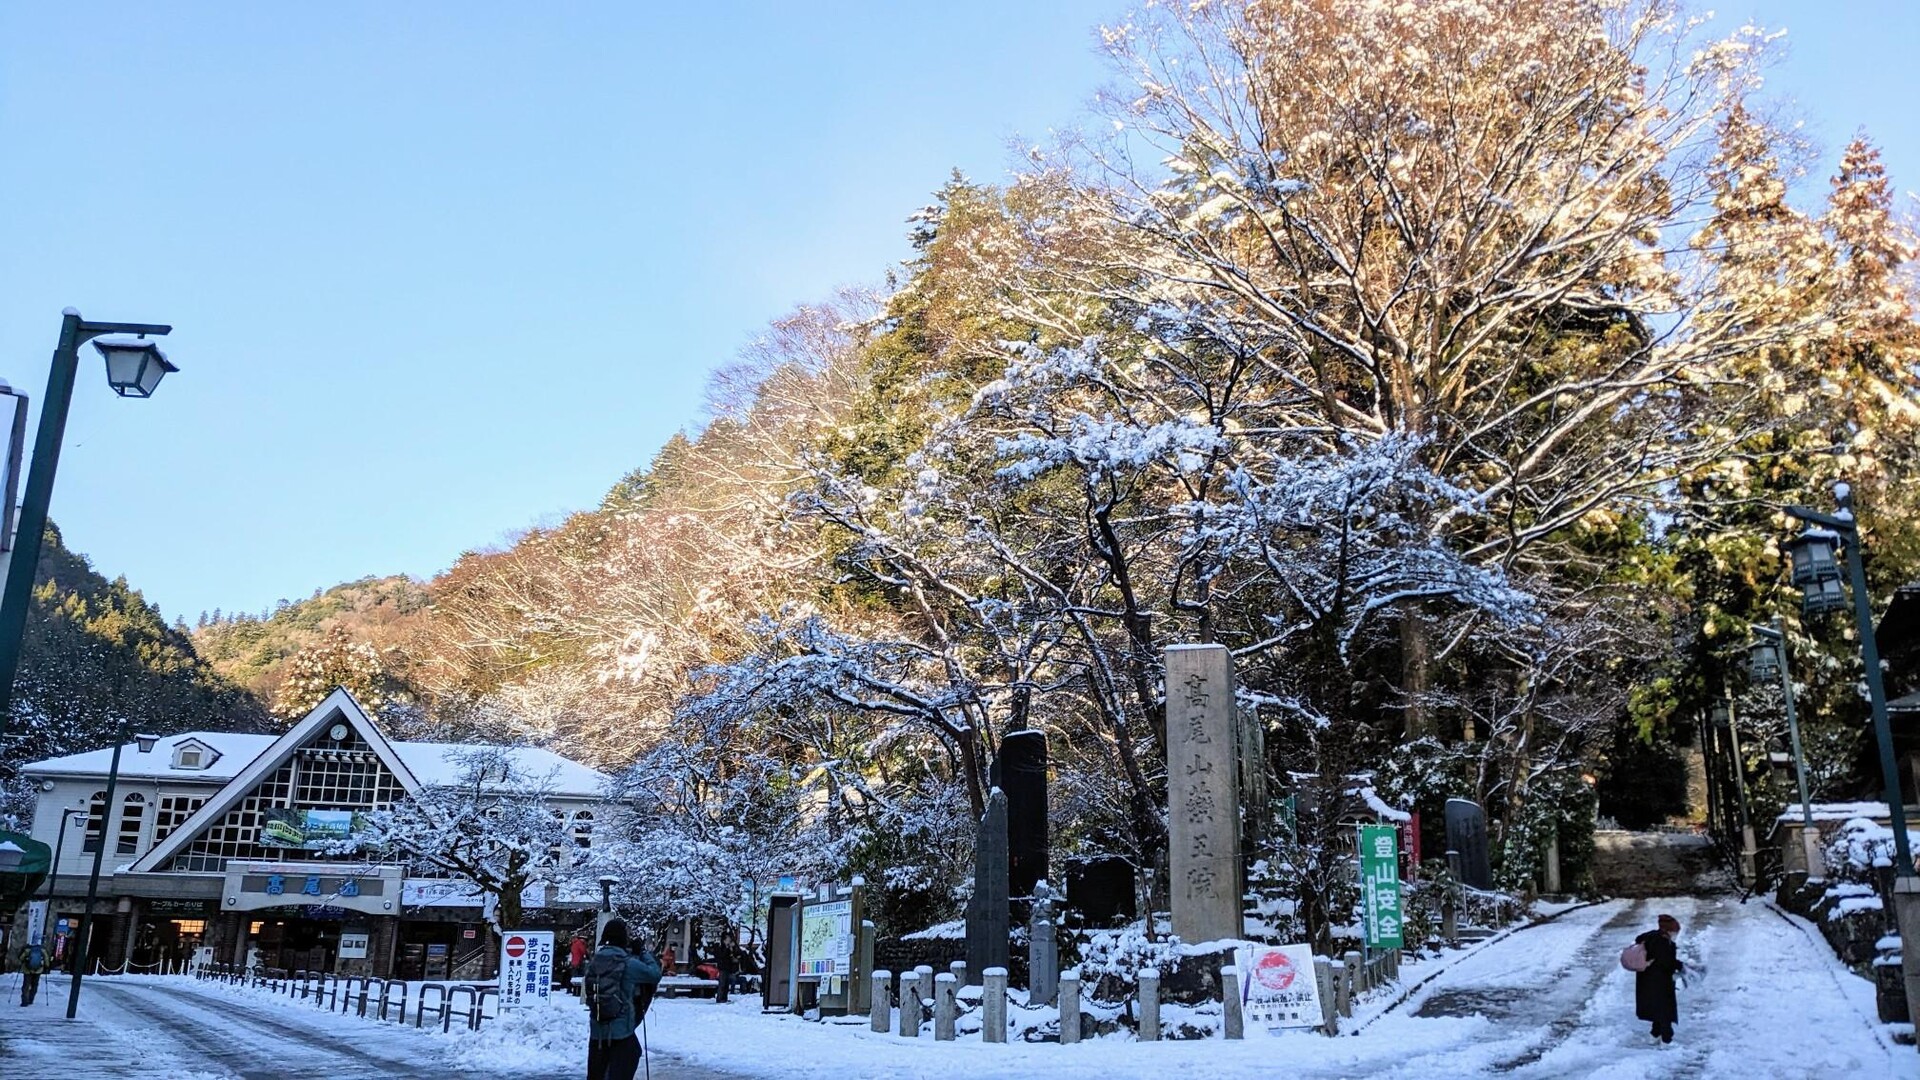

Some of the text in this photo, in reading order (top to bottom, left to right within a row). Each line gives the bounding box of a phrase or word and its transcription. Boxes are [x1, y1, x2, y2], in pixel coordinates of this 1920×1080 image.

[1374, 835, 1399, 938] 登山安全
[525, 937, 539, 994] 歩行者専用
